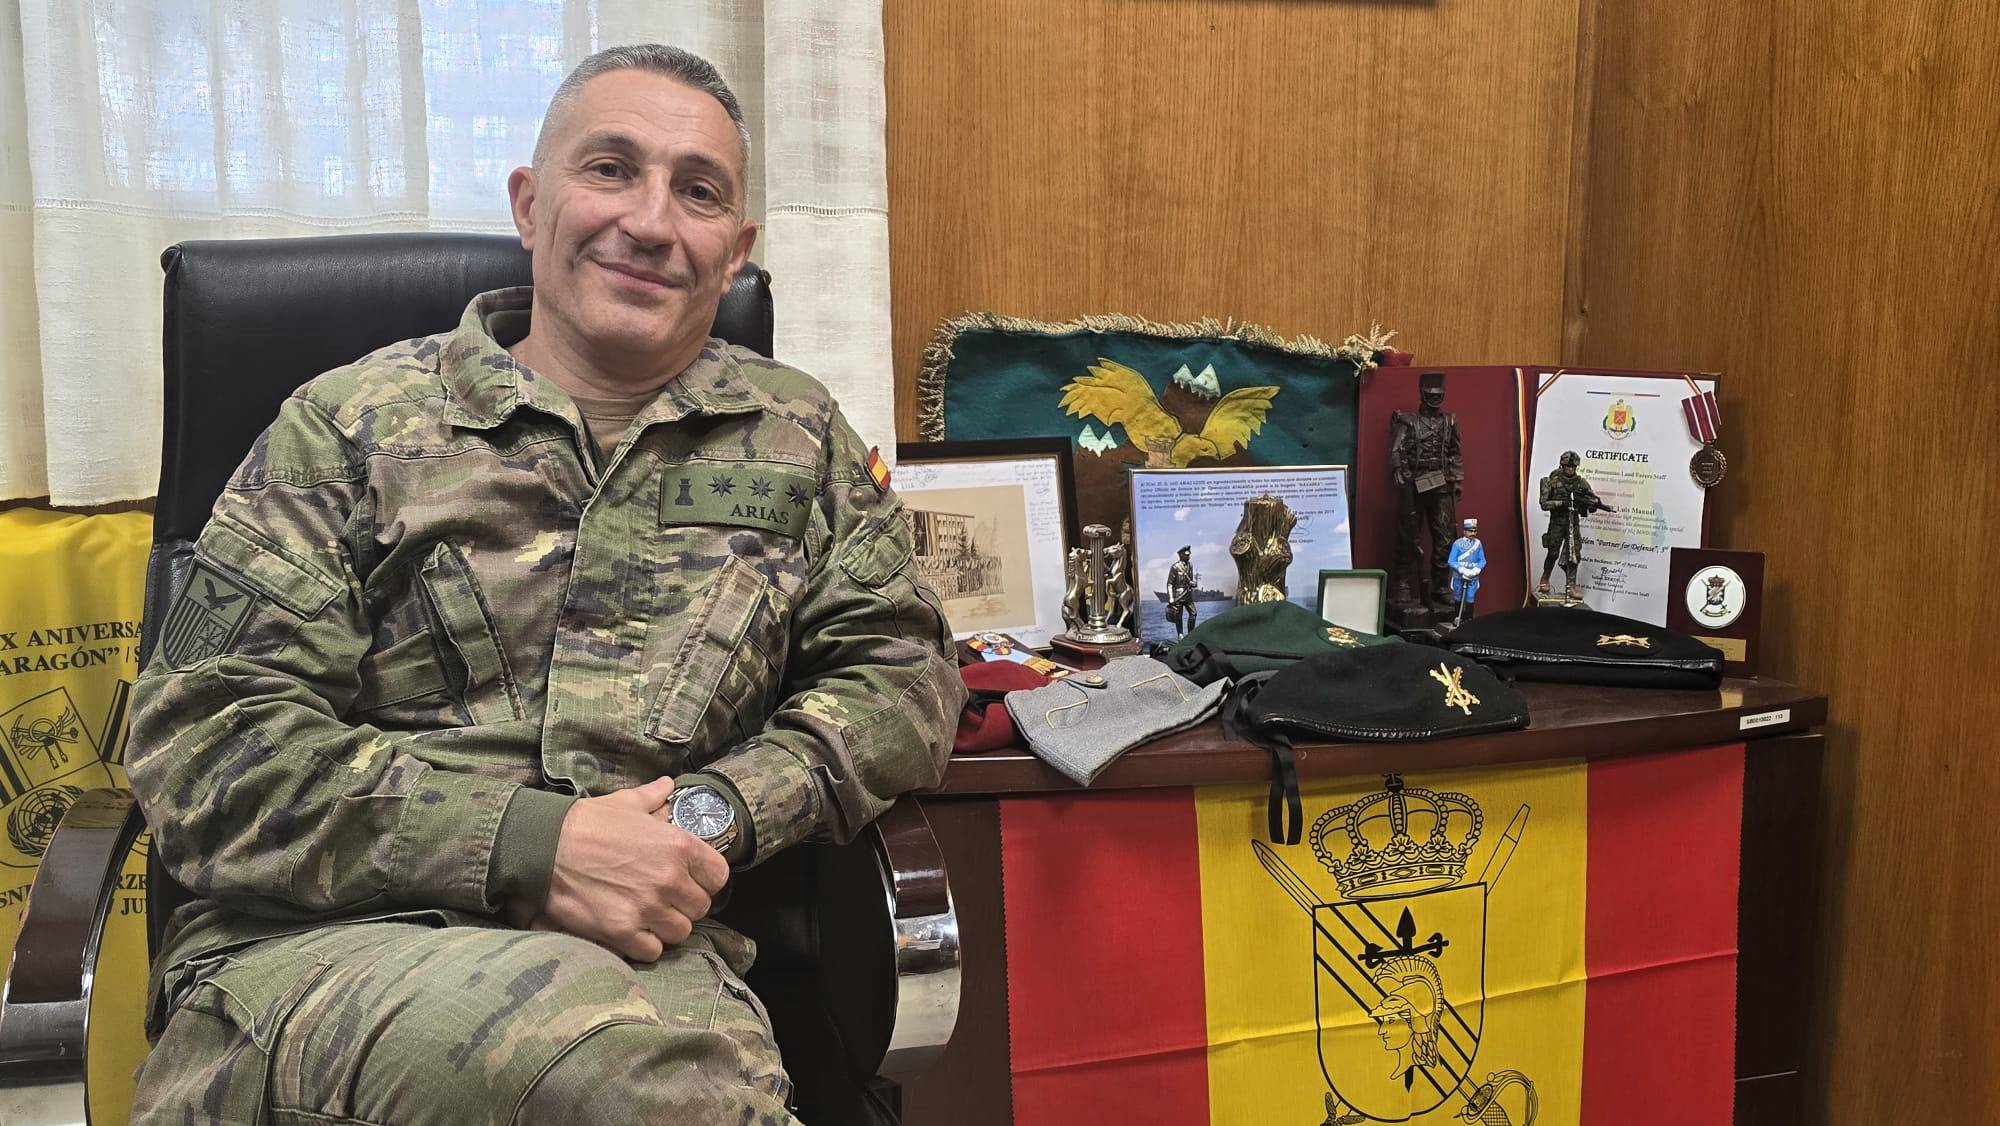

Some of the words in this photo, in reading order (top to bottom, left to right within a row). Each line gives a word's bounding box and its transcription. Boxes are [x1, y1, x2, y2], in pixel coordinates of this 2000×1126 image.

[1585, 449, 1649, 463] CERTIFICATE
[730, 503, 789, 525] ARIAS
[1631, 507, 1655, 516] Manuel
[1620, 540, 1630, 550] for
[121, 897, 147, 915] JU
